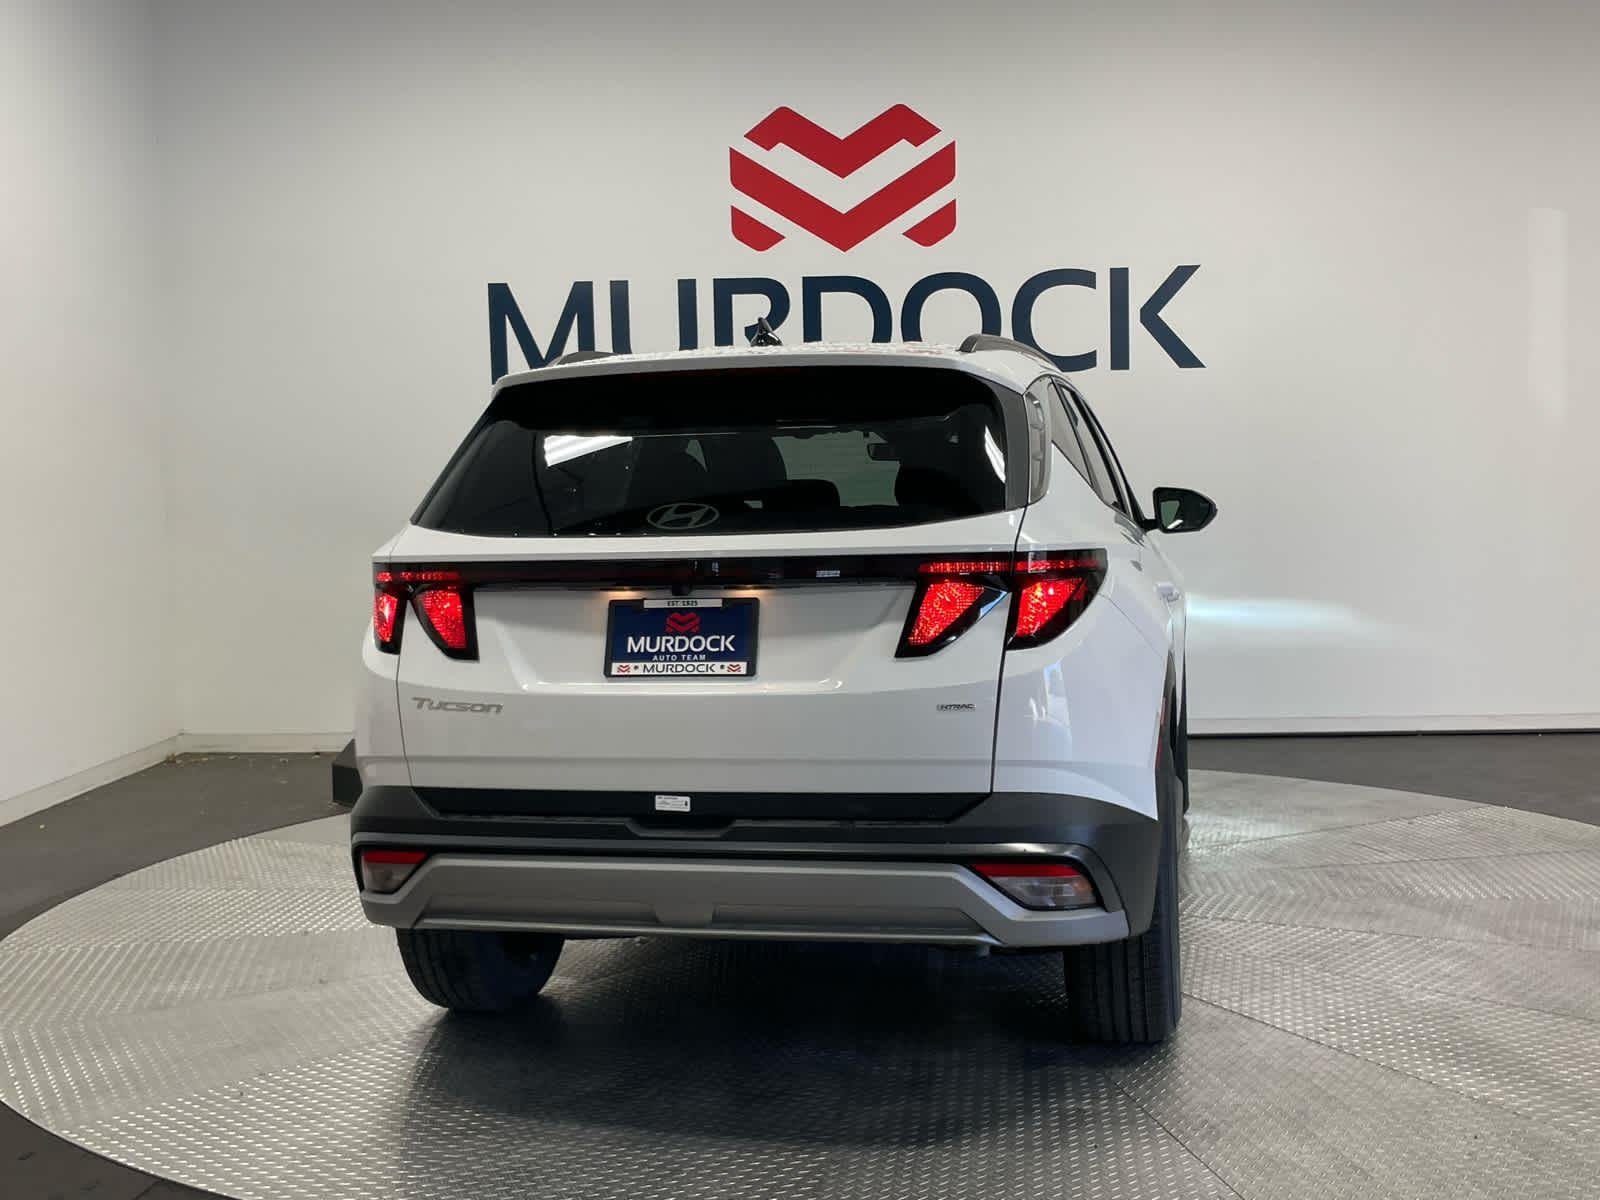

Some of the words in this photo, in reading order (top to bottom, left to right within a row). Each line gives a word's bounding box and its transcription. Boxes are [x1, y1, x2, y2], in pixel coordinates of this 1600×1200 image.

[487, 265, 1206, 384] MURDOCK
[627, 635, 736, 653] MURDOCK
[643, 663, 716, 673] MURDOCK
